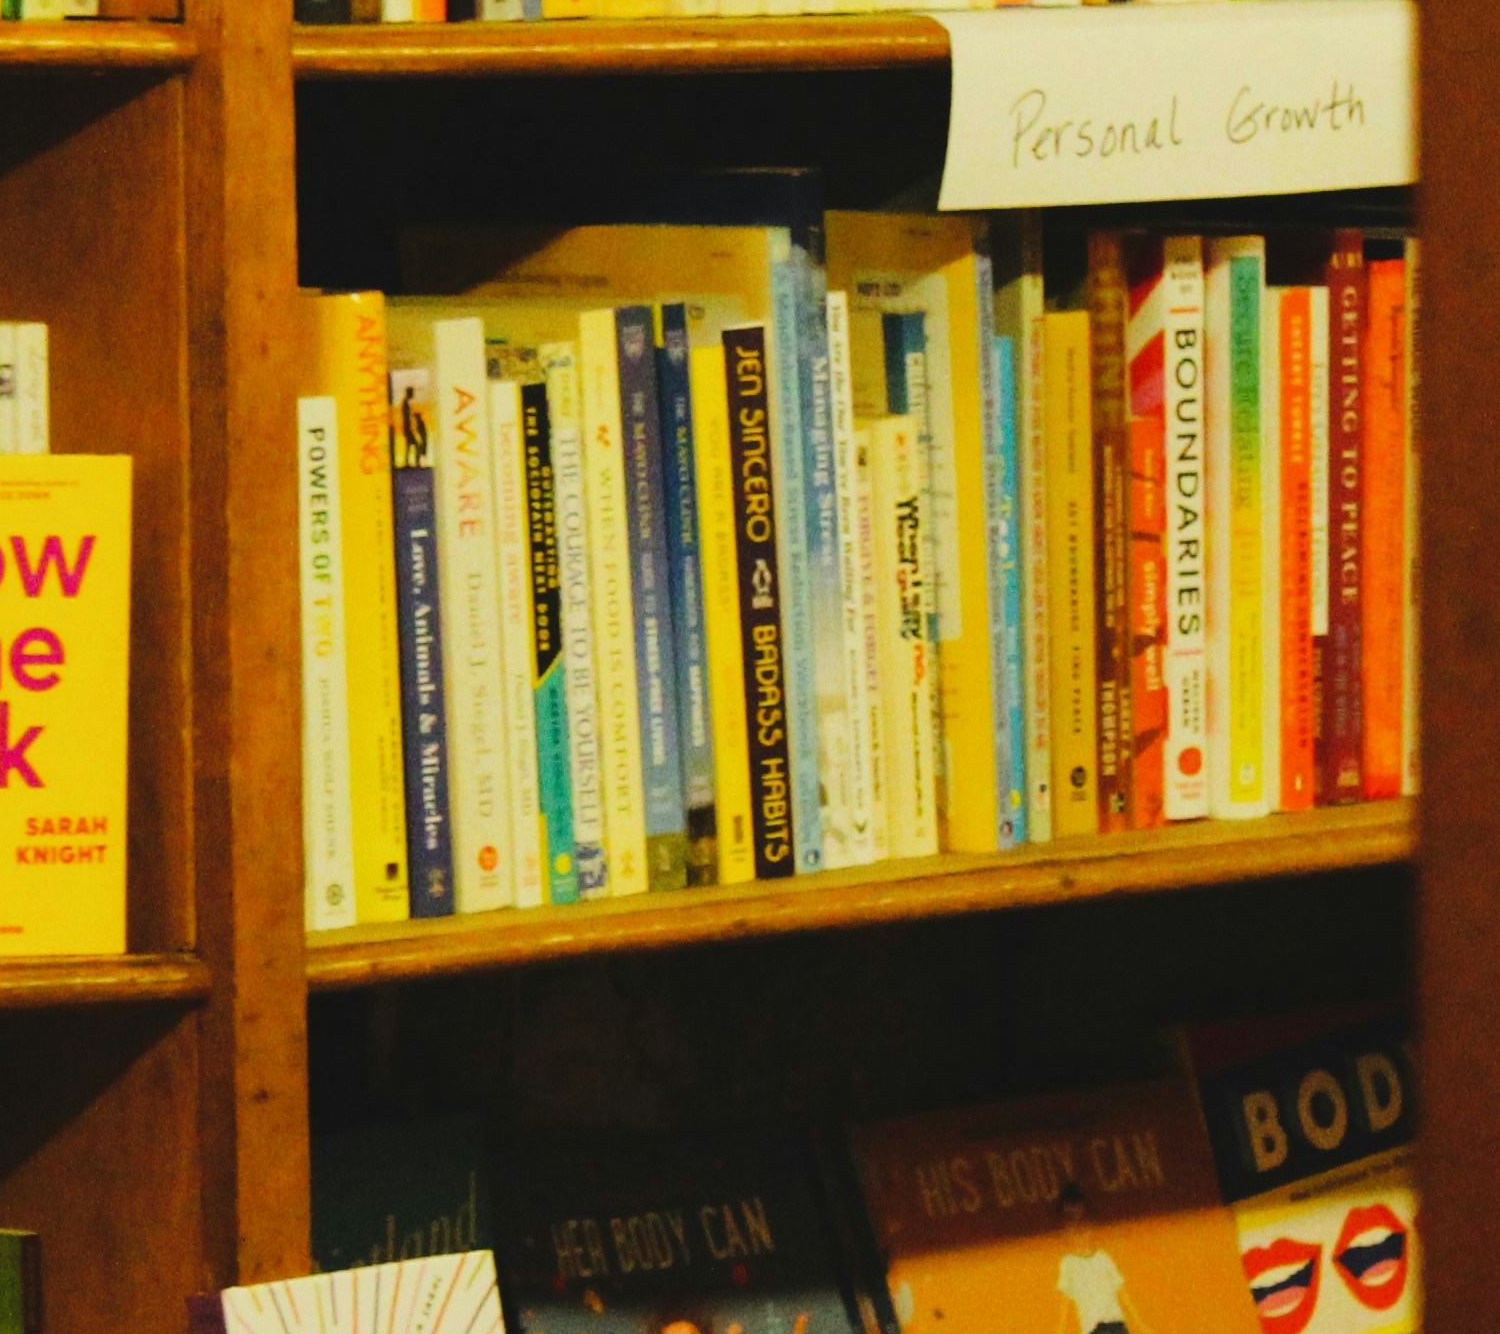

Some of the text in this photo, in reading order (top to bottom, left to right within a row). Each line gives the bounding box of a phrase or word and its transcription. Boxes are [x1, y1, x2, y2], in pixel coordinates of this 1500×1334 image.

[1010, 81, 1365, 169] Personal Growth
[307, 426, 334, 545] POWERS
[1175, 329, 1201, 638] BOUNDARIES
[311, 554, 335, 587] OF
[735, 345, 787, 863] JEN SINCERO BADASS HABITS
[411, 602, 434, 704] Animals
[26, 815, 108, 837] SARAH
[417, 741, 444, 849] Miracles
[17, 844, 108, 865] KNIGHT
[609, 1210, 691, 1273] BODY
[700, 1197, 775, 1259] CAN
